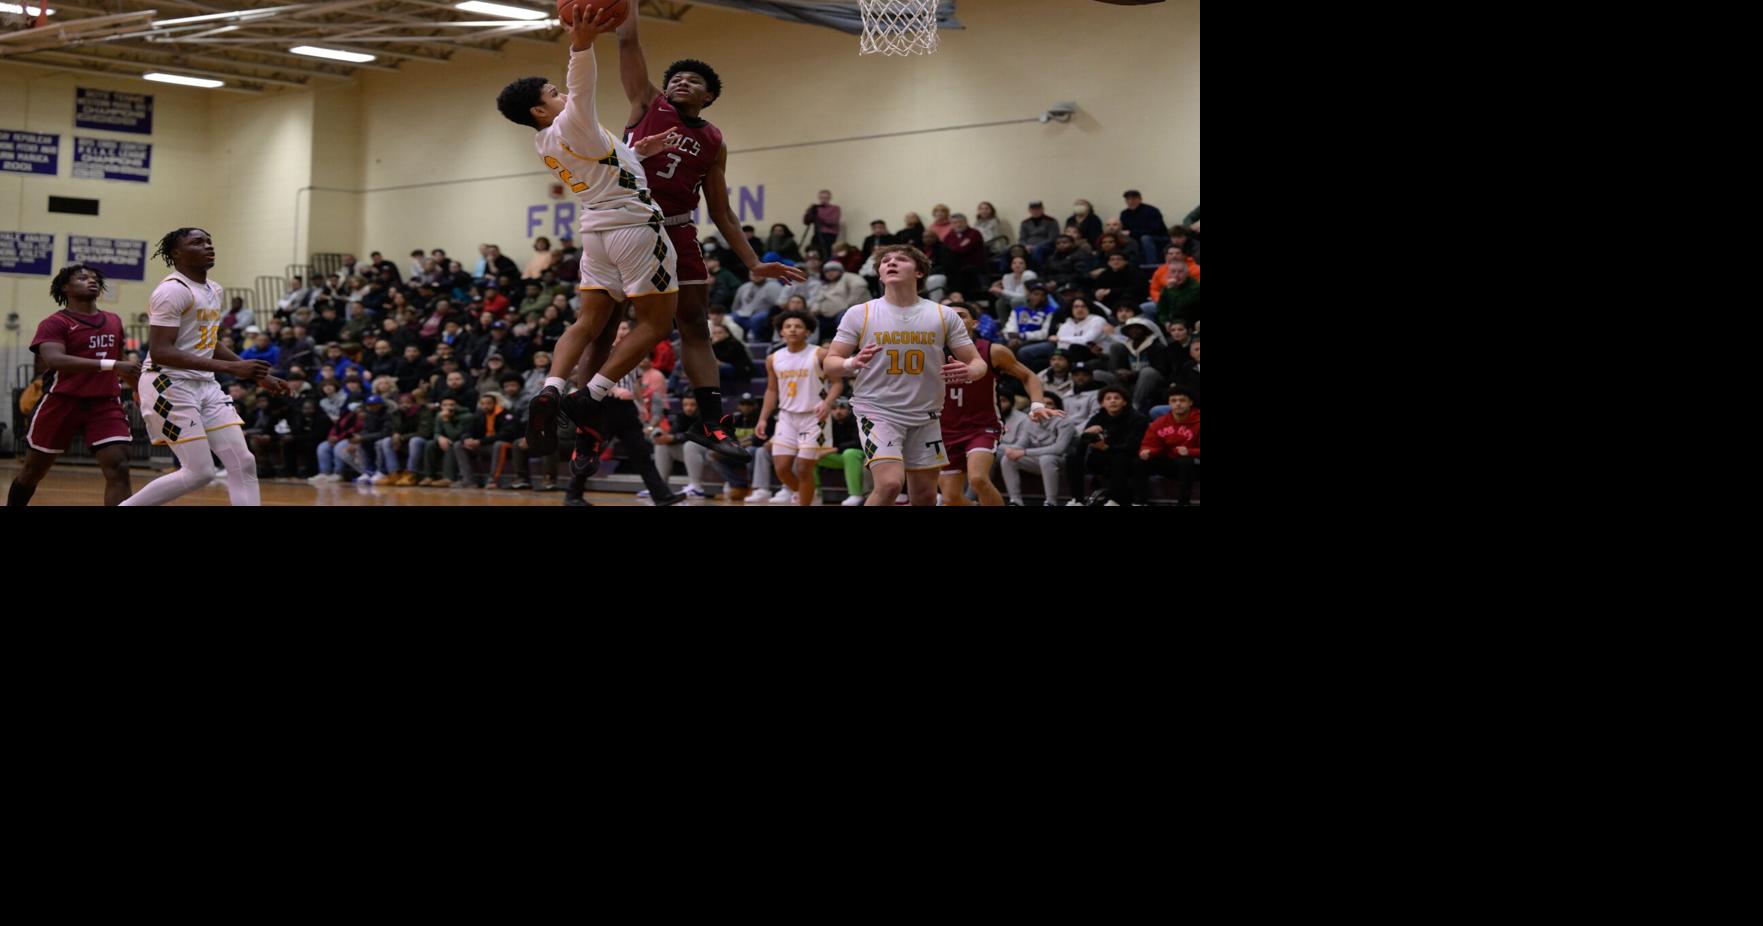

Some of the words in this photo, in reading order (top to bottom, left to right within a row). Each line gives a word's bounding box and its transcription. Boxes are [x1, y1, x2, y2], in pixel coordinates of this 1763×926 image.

[544, 155, 589, 193] 2
[656, 152, 682, 179] 3
[75, 254, 138, 266] CHAMPIONS
[89, 334, 115, 348] SICS
[873, 330, 937, 345] TACONIC
[886, 349, 925, 375] 10
[787, 381, 797, 398] 3
[950, 387, 963, 407] 4
